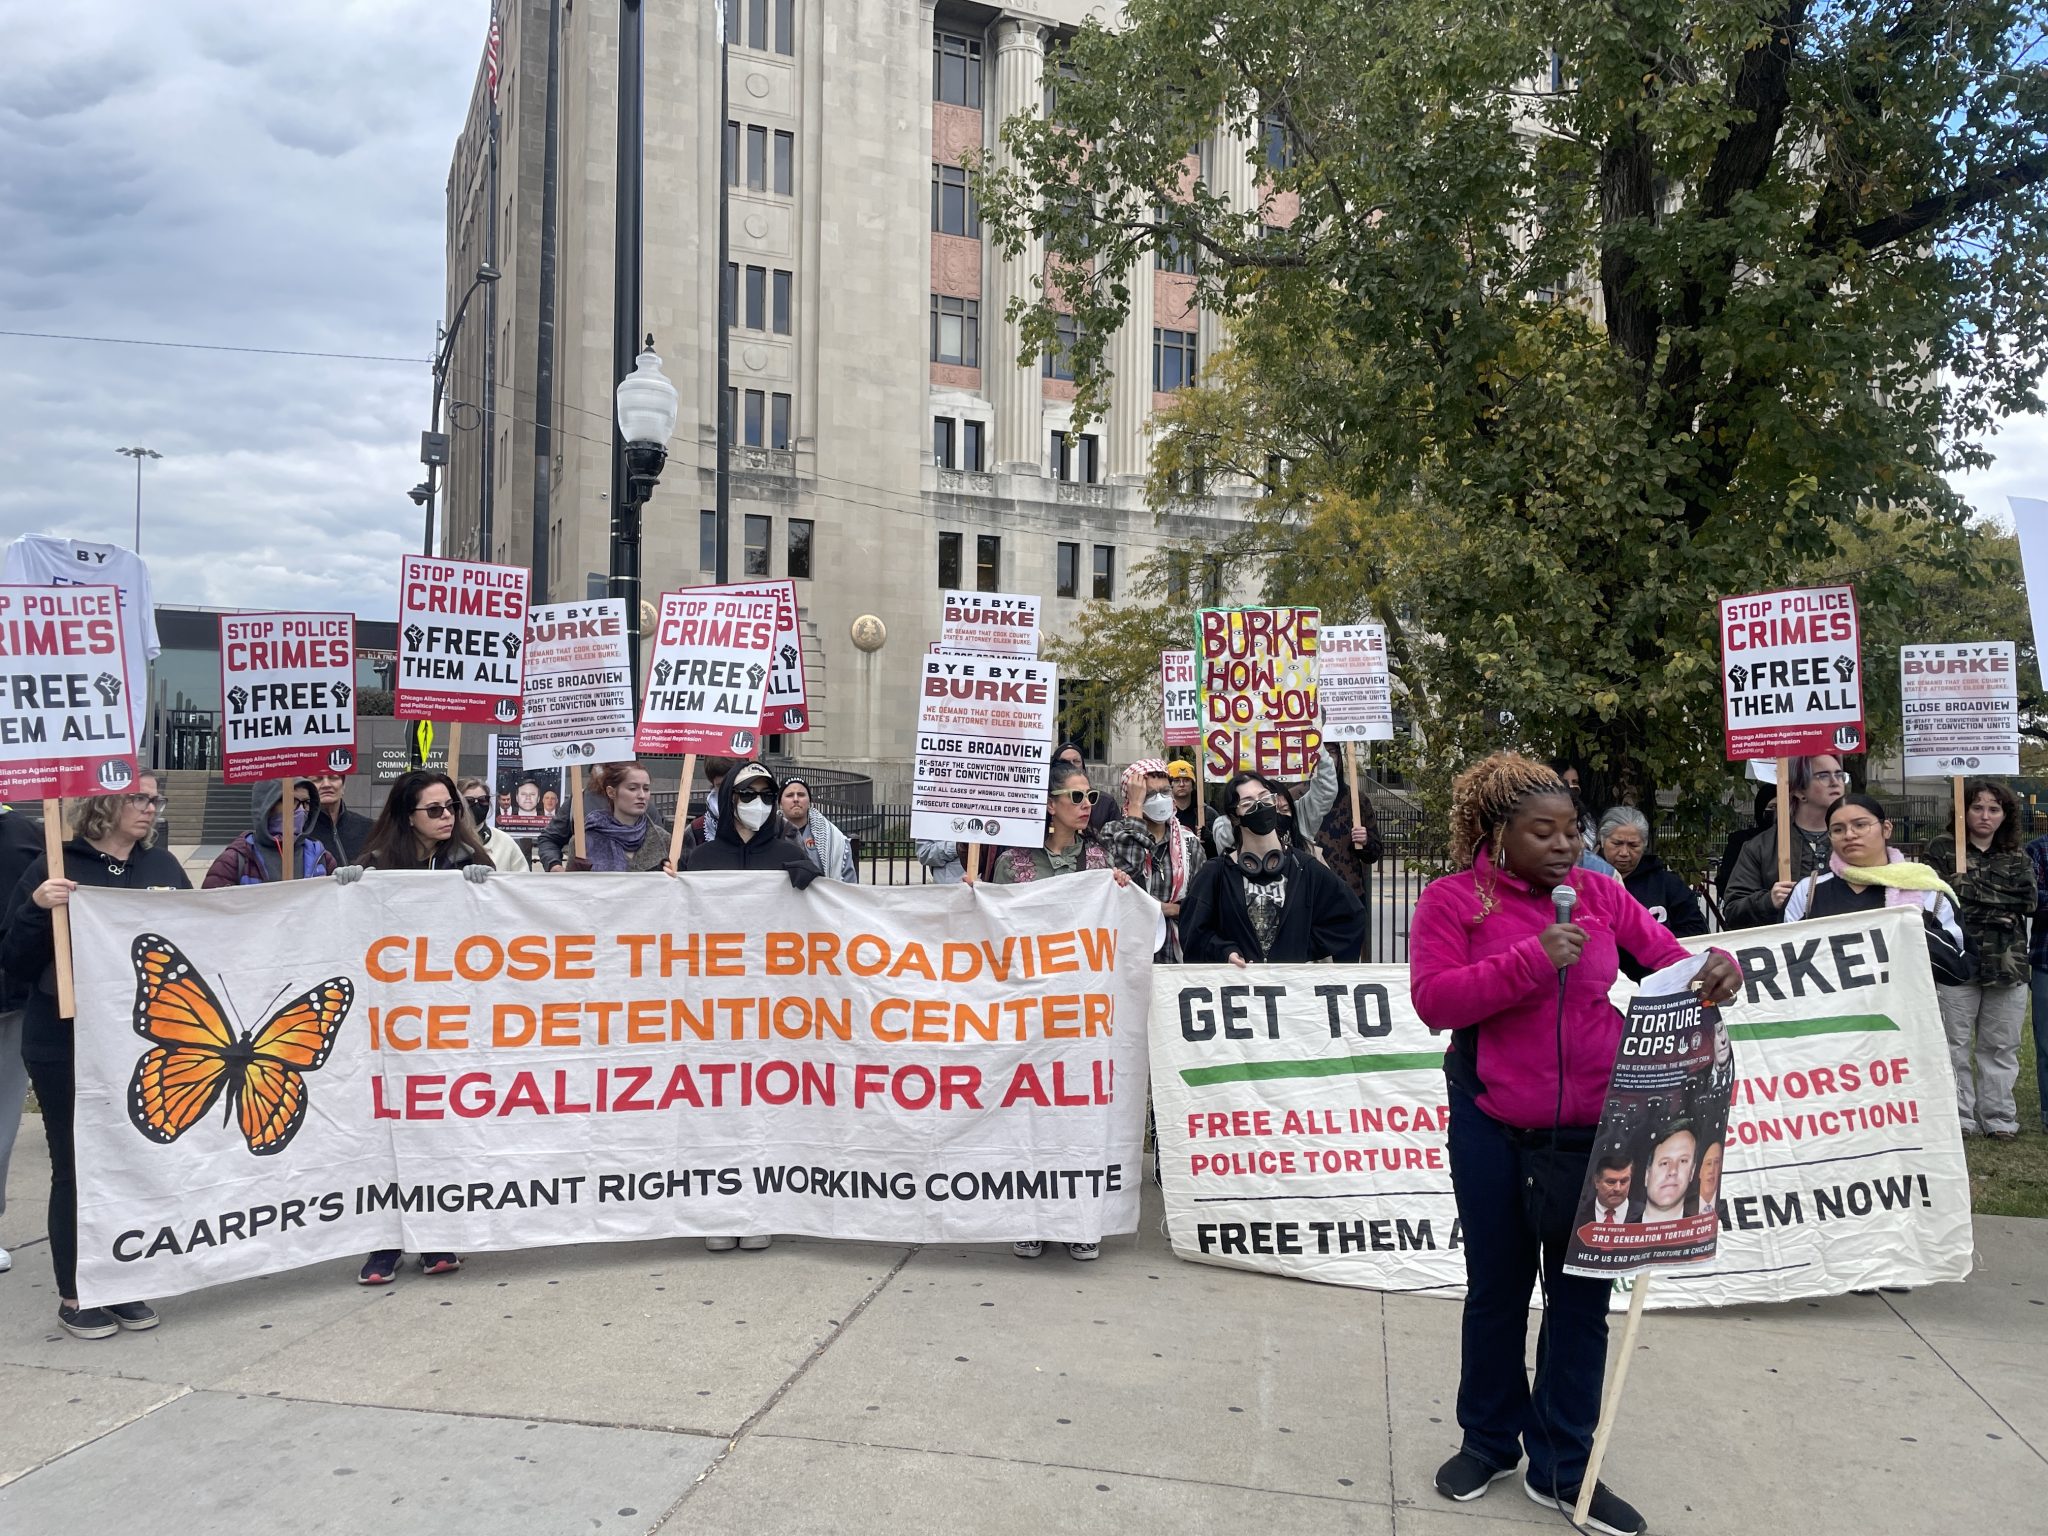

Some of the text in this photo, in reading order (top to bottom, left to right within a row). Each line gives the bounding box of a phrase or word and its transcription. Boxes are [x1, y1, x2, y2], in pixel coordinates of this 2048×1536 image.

[409, 563, 524, 589] STOP POLICE
[23, 595, 111, 616] POLICE
[407, 582, 523, 619] CRIMES
[665, 601, 774, 620] STOP POLICE
[946, 597, 982, 606] BYE
[1727, 593, 1850, 622] STOP POLICE
[945, 607, 1034, 627] BURKE
[227, 621, 348, 640] STOP POLICE
[660, 619, 772, 650] CRIMES
[1203, 609, 1319, 660] BURKE
[1727, 612, 1852, 652] CRIMES
[426, 626, 500, 658] FREE
[1320, 638, 1382, 653] URKE
[227, 640, 349, 672] CRIMES
[1165, 655, 1190, 665] STOP
[1904, 650, 1945, 659] BYE
[403, 656, 518, 684] THEM ALL
[671, 659, 745, 689] FREE
[927, 663, 975, 676] BYE
[1207, 659, 1276, 692] HOW
[1751, 656, 1831, 690] FREE
[1904, 657, 2009, 675] BURKE
[523, 671, 623, 692] LOSE BROADVIEW
[924, 676, 1048, 705] BURKE
[1337, 676, 1385, 686] BROADVIEW
[252, 682, 328, 712] FREE
[527, 697, 625, 714] POST CONVICTION UNITS
[649, 690, 759, 715] THEM ALL
[1730, 688, 1857, 718] THEM ALL
[1905, 701, 2010, 713] CLOSE BROADVIEW
[926, 705, 1042, 720] WE DEMAND THAT COOK COUNTY
[1209, 694, 1254, 723] DO
[62, 713, 126, 741] ALL
[229, 713, 350, 740] THEM ALL
[922, 714, 950, 723] STATE'S
[952, 716, 989, 726] ATTORNEY
[991, 719, 1016, 728] EILEEN
[1914, 721, 2011, 731] POST CONVICTION UNITS
[382, 750, 406, 758] COOK
[498, 748, 520, 756] COPS
[921, 738, 1043, 759] CLOSE BROADVIEW
[29, 764, 58, 776] Against
[919, 759, 950, 768] RE-STAFF
[966, 762, 1006, 772] CONVICTION
[1007, 765, 1041, 775] INTEGRITY
[928, 767, 952, 778] POST
[955, 770, 1010, 782] CONVICTION
[1013, 773, 1041, 784] UNITS
[12, 775, 57, 785] Repression
[950, 787, 968, 795] CASES
[977, 789, 1006, 798] WRONGFUL
[1007, 791, 1039, 800] CONVICTION
[916, 799, 950, 808] PROSECUTE
[951, 802, 1002, 812] CORRUPT/KILLER
[1003, 805, 1020, 814] COPS
[365, 927, 1118, 983] CLOSE THE BROADVIEW
[1178, 928, 1890, 1042] GET TO RKE!
[368, 1004, 471, 1051] ICE
[492, 996, 852, 1048] DETENTION
[1630, 1006, 1703, 1033] TORTURE
[1622, 1035, 1676, 1056] COPS
[371, 1060, 835, 1120] LEGALIZATION
[854, 1063, 984, 1111] FOR
[1187, 1110, 1273, 1138] FREE
[1281, 1108, 1342, 1135] ALL
[1869, 1057, 1910, 1088] OF
[1190, 1100, 1920, 1176] POLICE TORTURE CONVICTION!
[111, 1191, 344, 1263] CAARPR'S
[355, 1175, 586, 1215] IMMIGRANT
[599, 1166, 743, 1202] RIGHTS
[753, 1164, 916, 1201] WORKING
[1196, 1221, 1303, 1255] FREE
[1308, 1218, 1436, 1254] THEM
[1812, 1173, 1932, 1222] NOW!
[1591, 1224, 1712, 1244] 3RD GENERATION TORTURE COPS
[1577, 1252, 1599, 1261] HELP
[1601, 1255, 1612, 1263] US
[1613, 1255, 1628, 1263] END
[1629, 1251, 1651, 1262] POLICE
[1652, 1249, 1681, 1258] TORTURE
